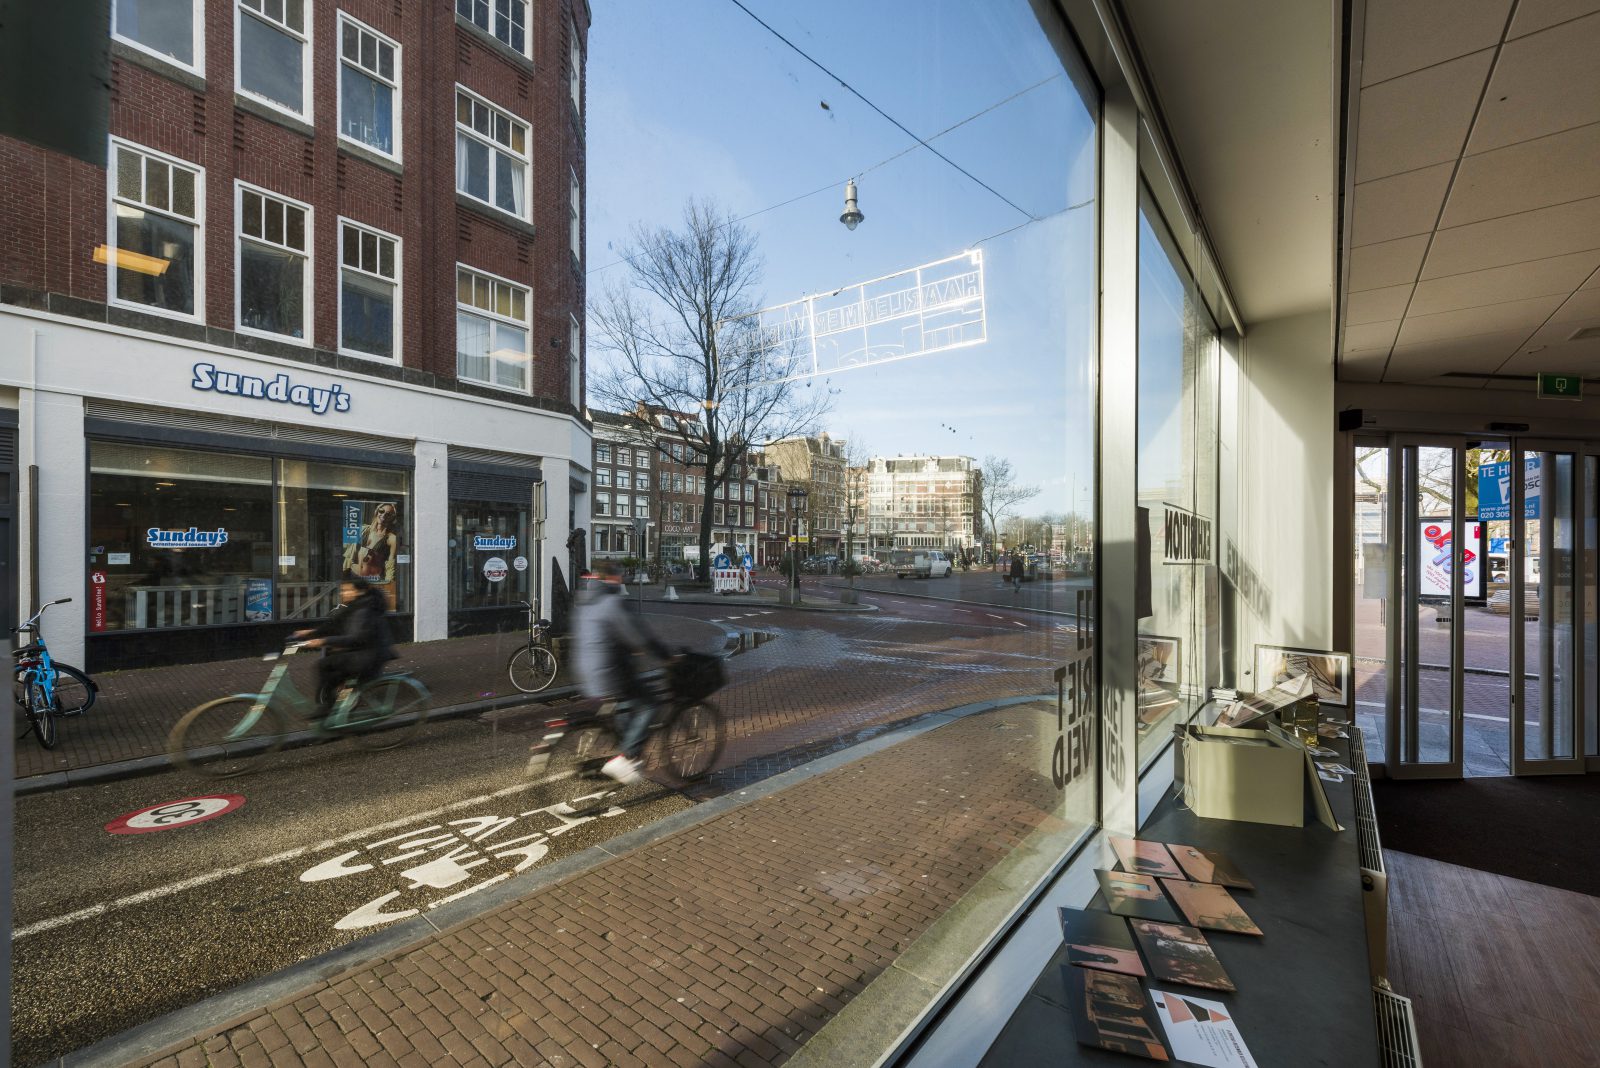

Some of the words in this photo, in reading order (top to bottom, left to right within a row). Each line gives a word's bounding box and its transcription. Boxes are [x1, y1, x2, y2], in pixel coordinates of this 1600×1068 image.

[192, 363, 350, 415] Sunday's
[1481, 466, 1495, 478] TE
[147, 528, 228, 545] Sunday's
[475, 535, 516, 548] Sunday's
